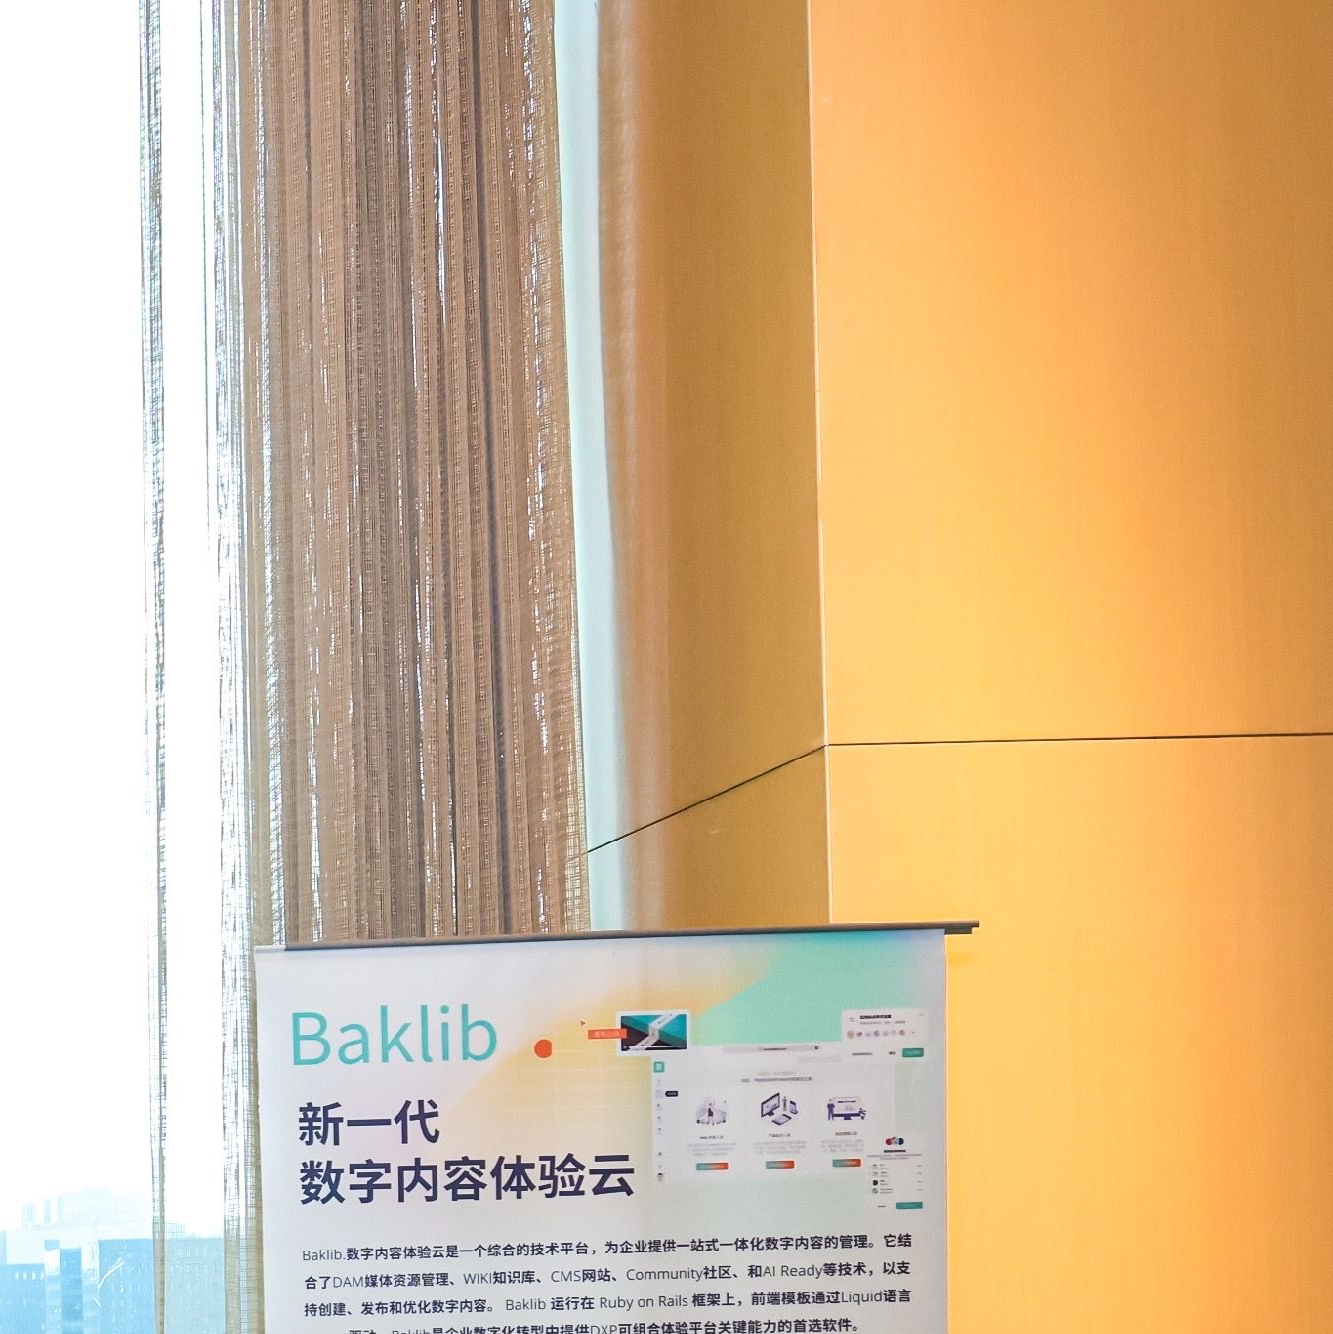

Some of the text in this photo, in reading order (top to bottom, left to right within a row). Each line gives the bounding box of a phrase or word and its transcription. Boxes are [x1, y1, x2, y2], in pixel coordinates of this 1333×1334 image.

[291, 1003, 498, 1066] Baklib
[297, 1098, 440, 1147] 新一代
[299, 1152, 636, 1206] 数字内容体验云
[505, 1298, 547, 1312] Baklib
[550, 1295, 595, 1311] 运行在
[600, 1295, 634, 1312] Ruby
[637, 1297, 654, 1307] on
[658, 1294, 688, 1307] Rails
